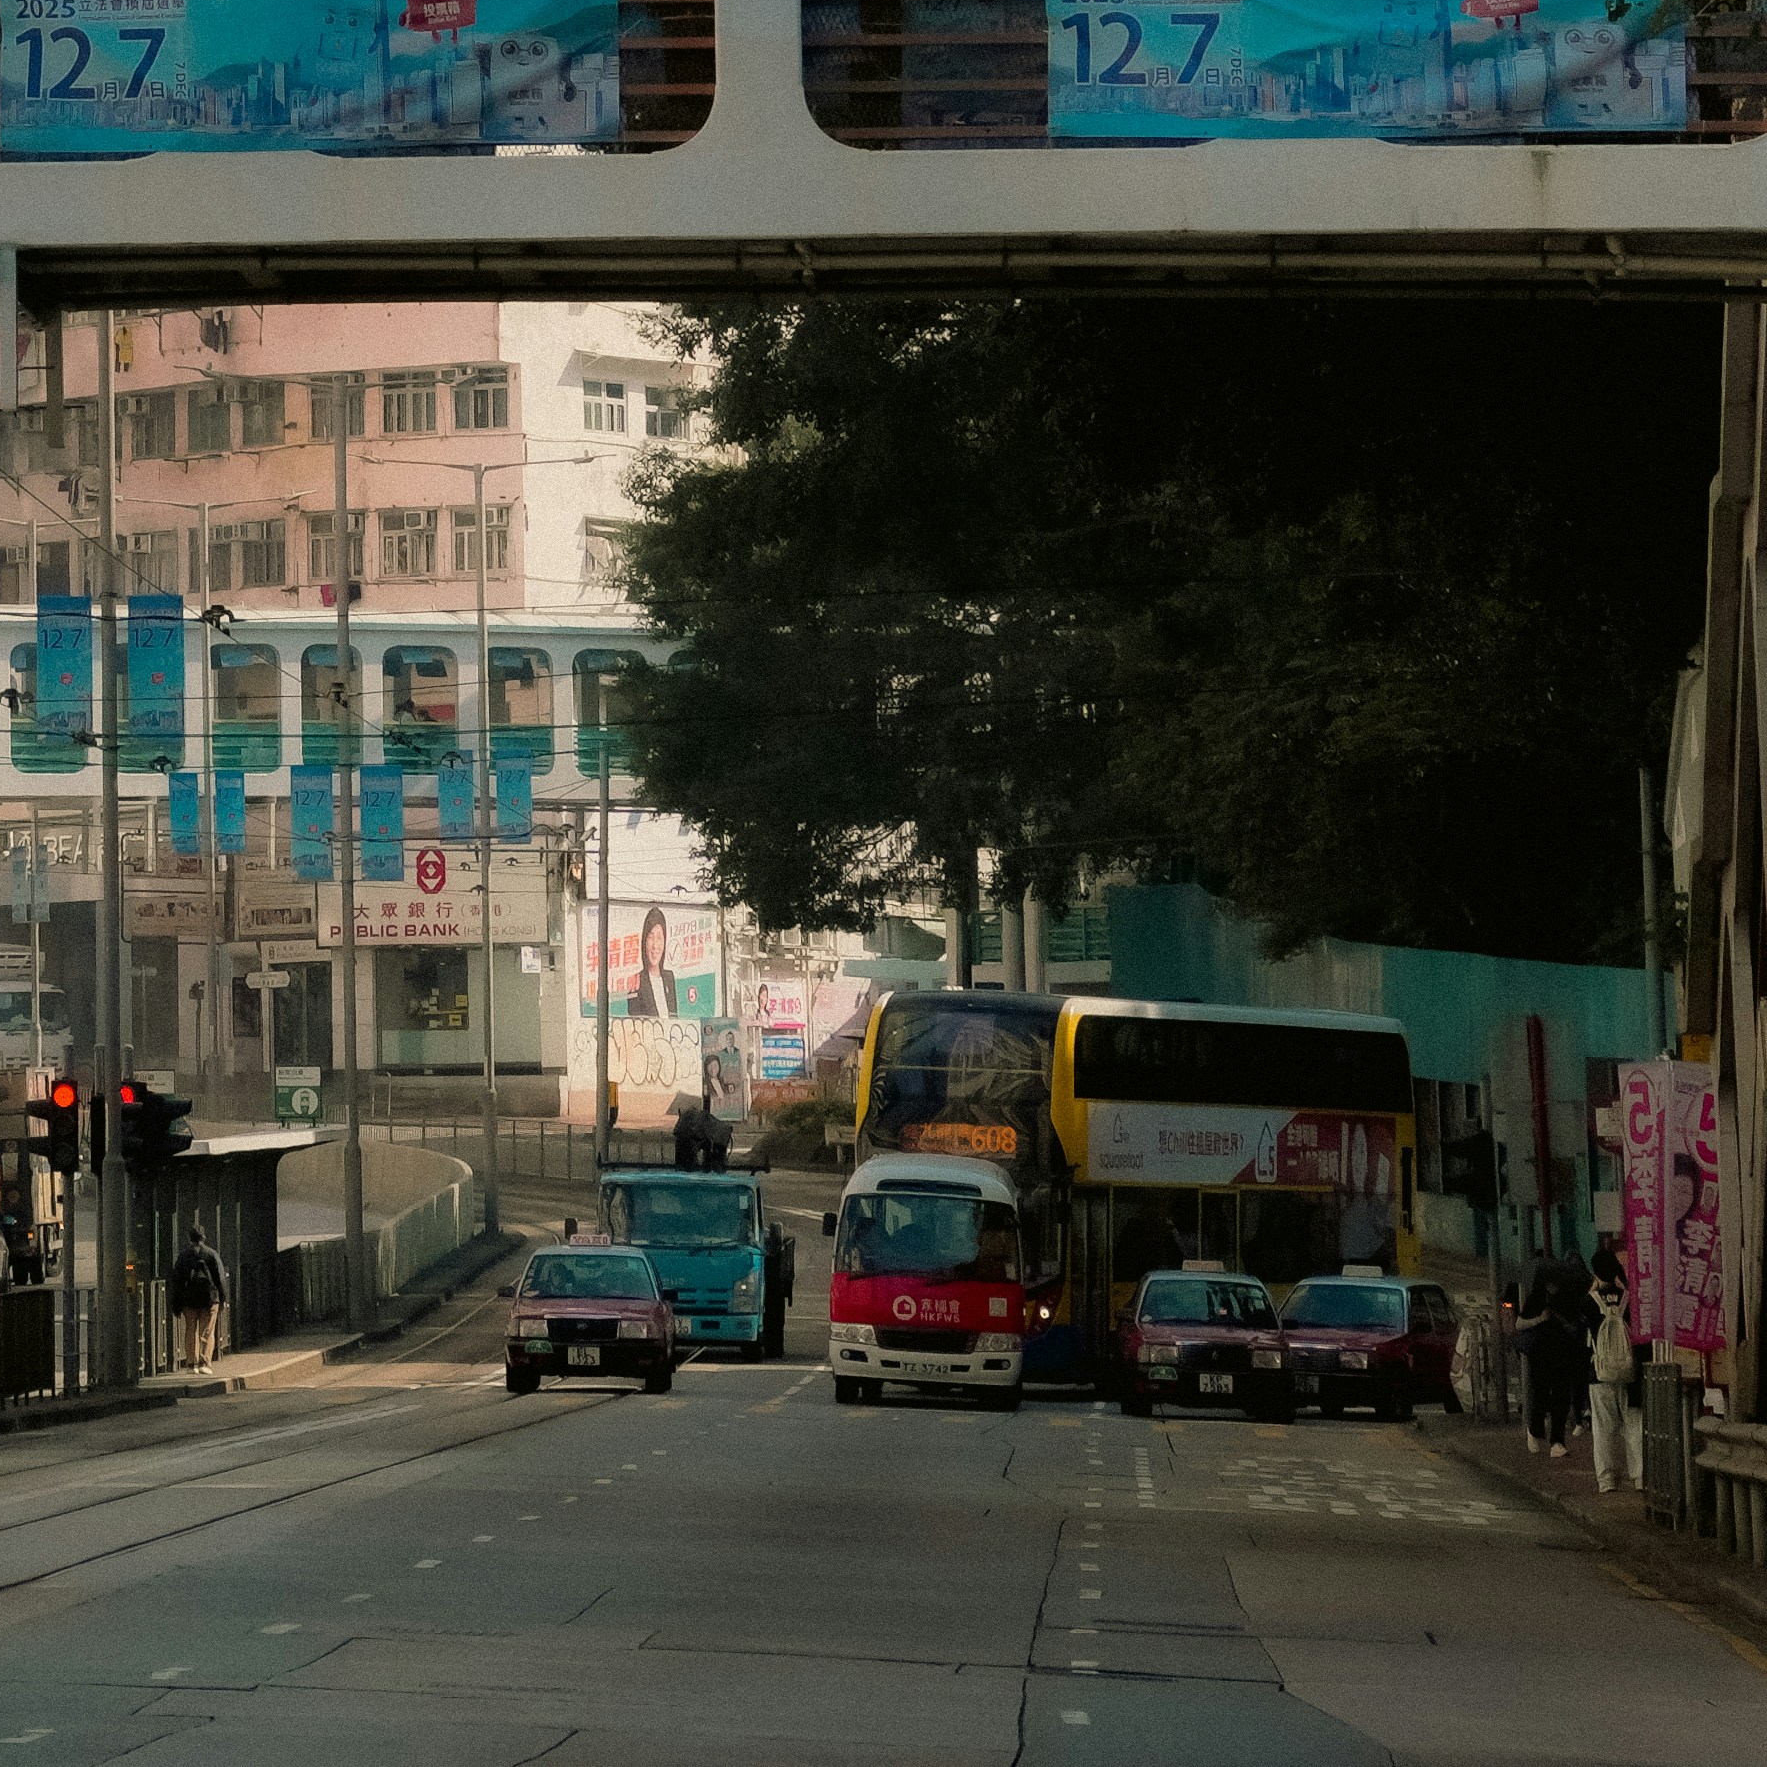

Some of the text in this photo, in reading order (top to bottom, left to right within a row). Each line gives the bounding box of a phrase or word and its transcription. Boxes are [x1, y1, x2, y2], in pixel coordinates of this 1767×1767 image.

[41, 628, 83, 649] 12 7
[134, 627, 175, 648] 12 7
[294, 790, 328, 806] 12 7
[364, 791, 396, 807] 12 7
[353, 902, 454, 919] 大眾銀行
[330, 924, 399, 938] PBLIC
[404, 923, 461, 938] BANK
[463, 924, 499, 937] (HOG
[972, 1125, 1018, 1154] 608
[1099, 1153, 1144, 1169] squarefoot
[572, 1236, 609, 1246] TAXI
[920, 1298, 961, 1314] 家福會
[920, 1311, 961, 1324] HKFWS
[903, 1362, 949, 1375] TZ 3742
